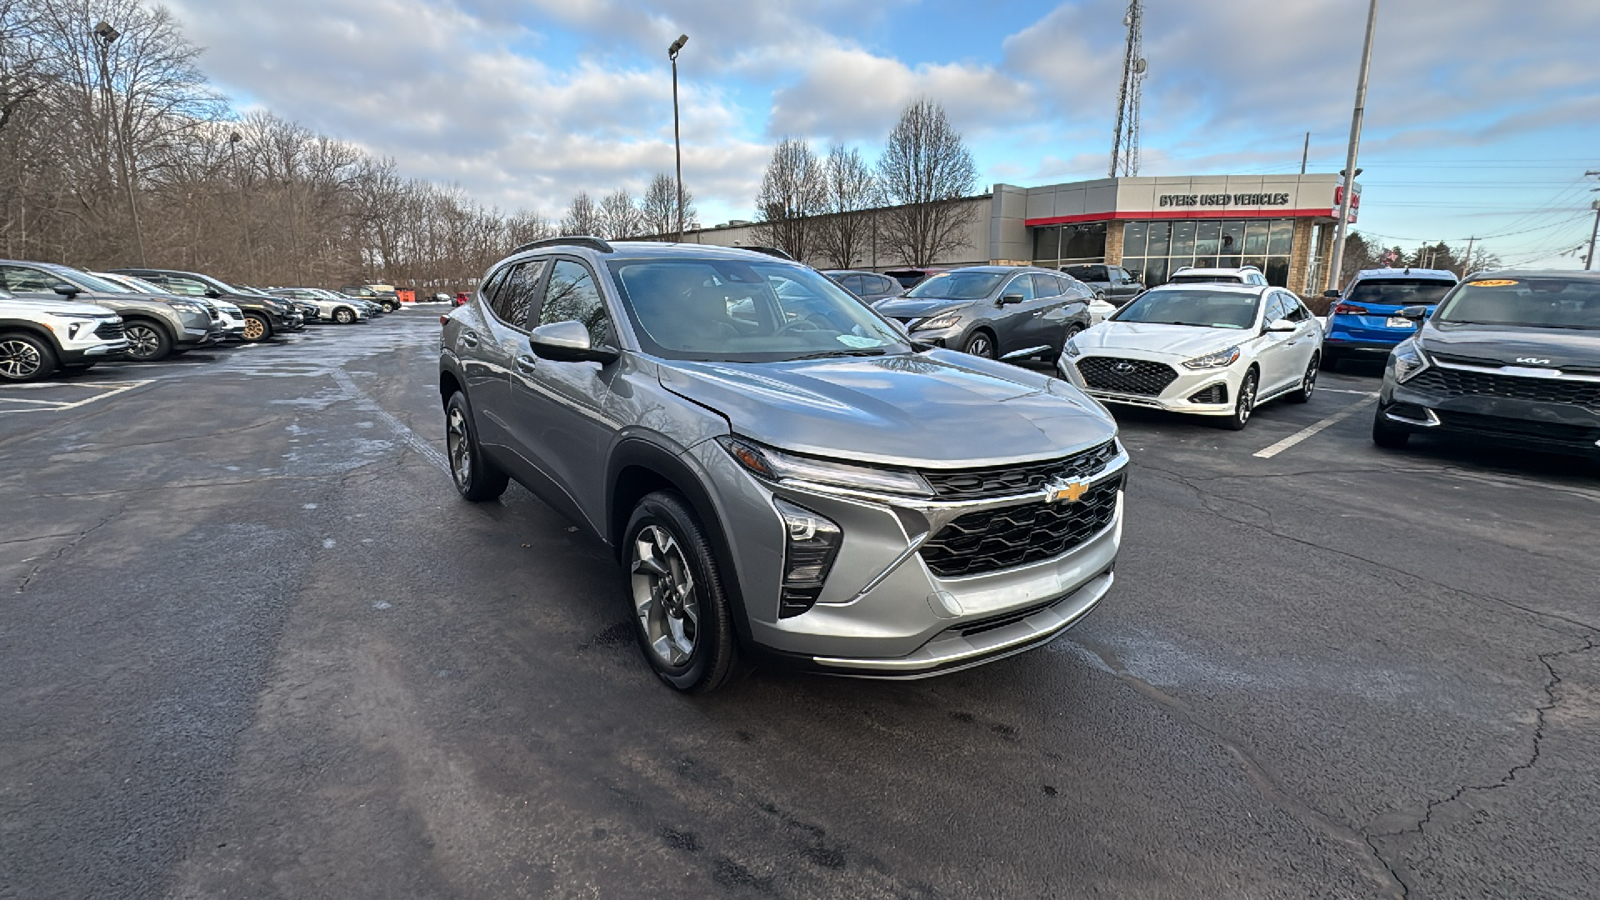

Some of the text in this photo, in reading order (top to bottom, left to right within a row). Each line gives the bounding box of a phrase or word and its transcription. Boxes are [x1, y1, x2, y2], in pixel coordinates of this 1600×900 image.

[1159, 193, 1289, 207] BYERS USED VEHICLES
